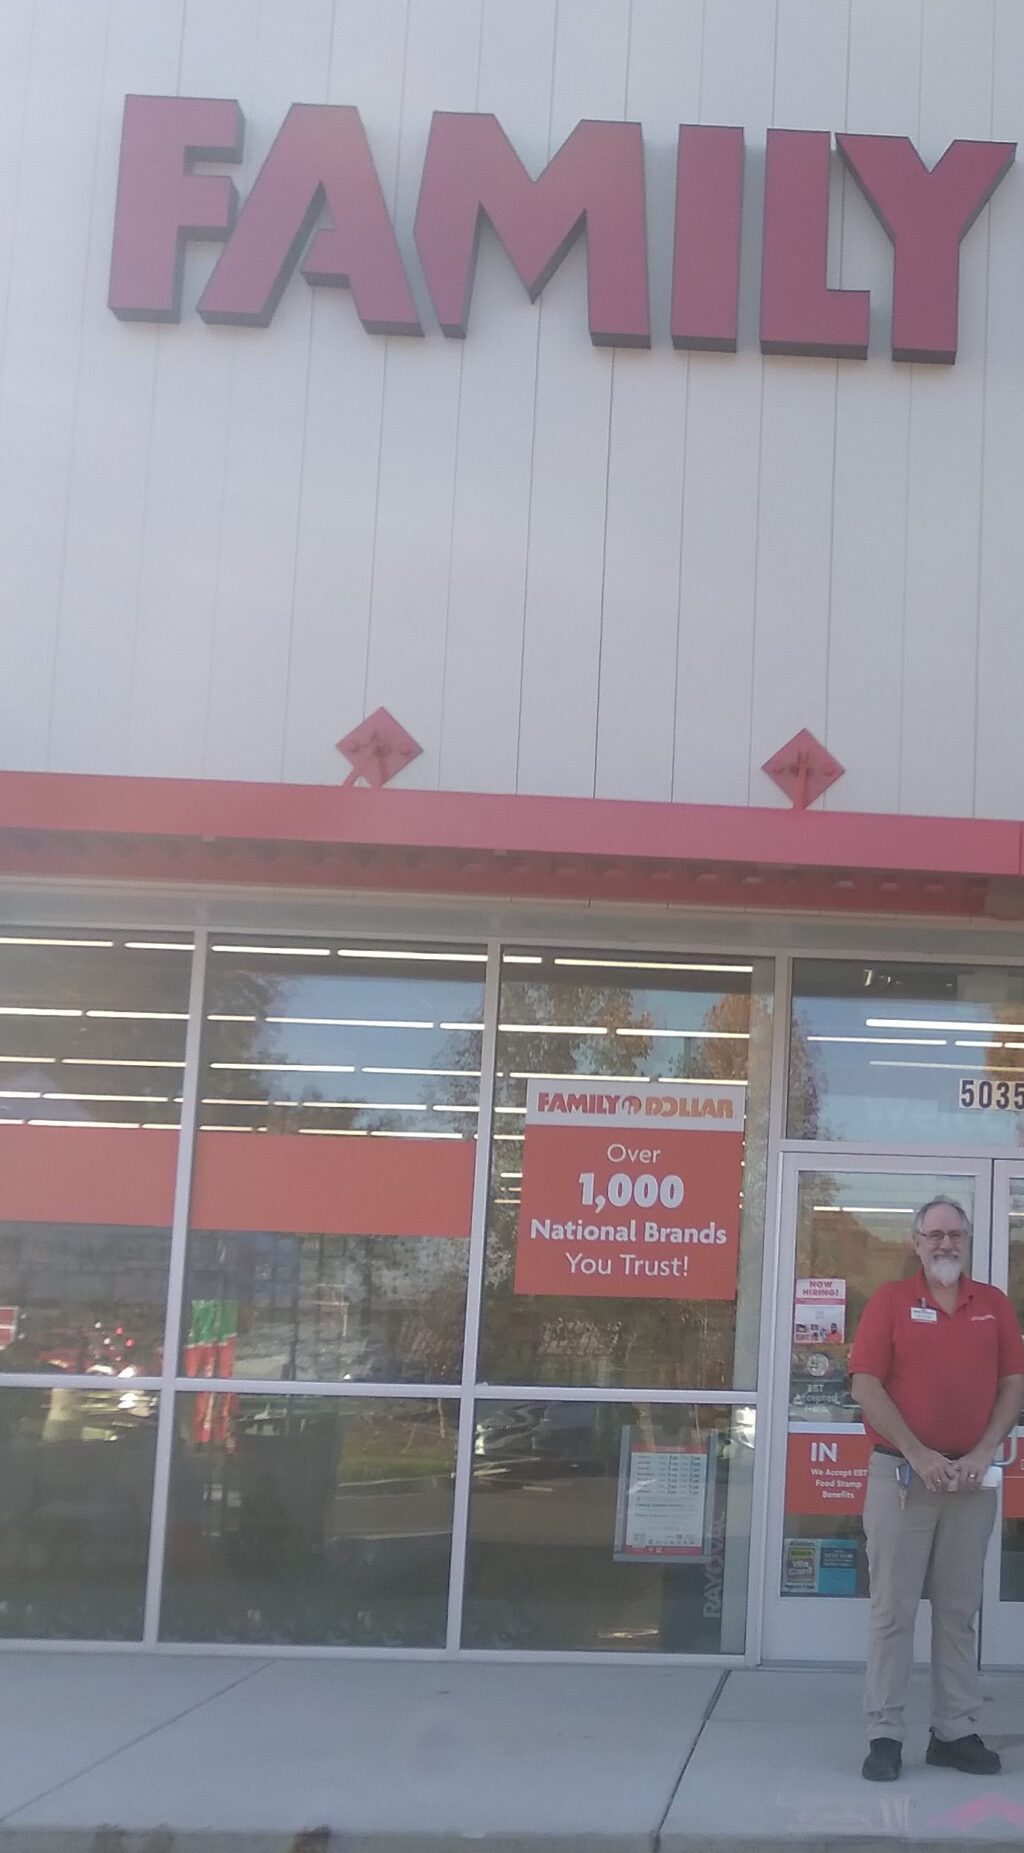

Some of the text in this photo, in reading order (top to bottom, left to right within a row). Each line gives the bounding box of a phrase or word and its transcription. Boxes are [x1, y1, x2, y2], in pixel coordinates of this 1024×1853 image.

[108, 94, 1018, 365] FAMILY
[537, 1091, 734, 1119] FAMILY DOLLAR
[607, 1143, 661, 1163] Over
[578, 1172, 684, 1213] 1,000
[530, 1219, 727, 1245] National Brands
[565, 1252, 689, 1277] You Trust!
[802, 1288, 839, 1297] HIRING!
[809, 1280, 833, 1288] NOW
[810, 1442, 838, 1463] IN
[810, 1468, 824, 1476] We
[824, 1468, 852, 1478] Accept
[815, 1479, 862, 1489] Food Stamp
[821, 1490, 854, 1499] Benefits
